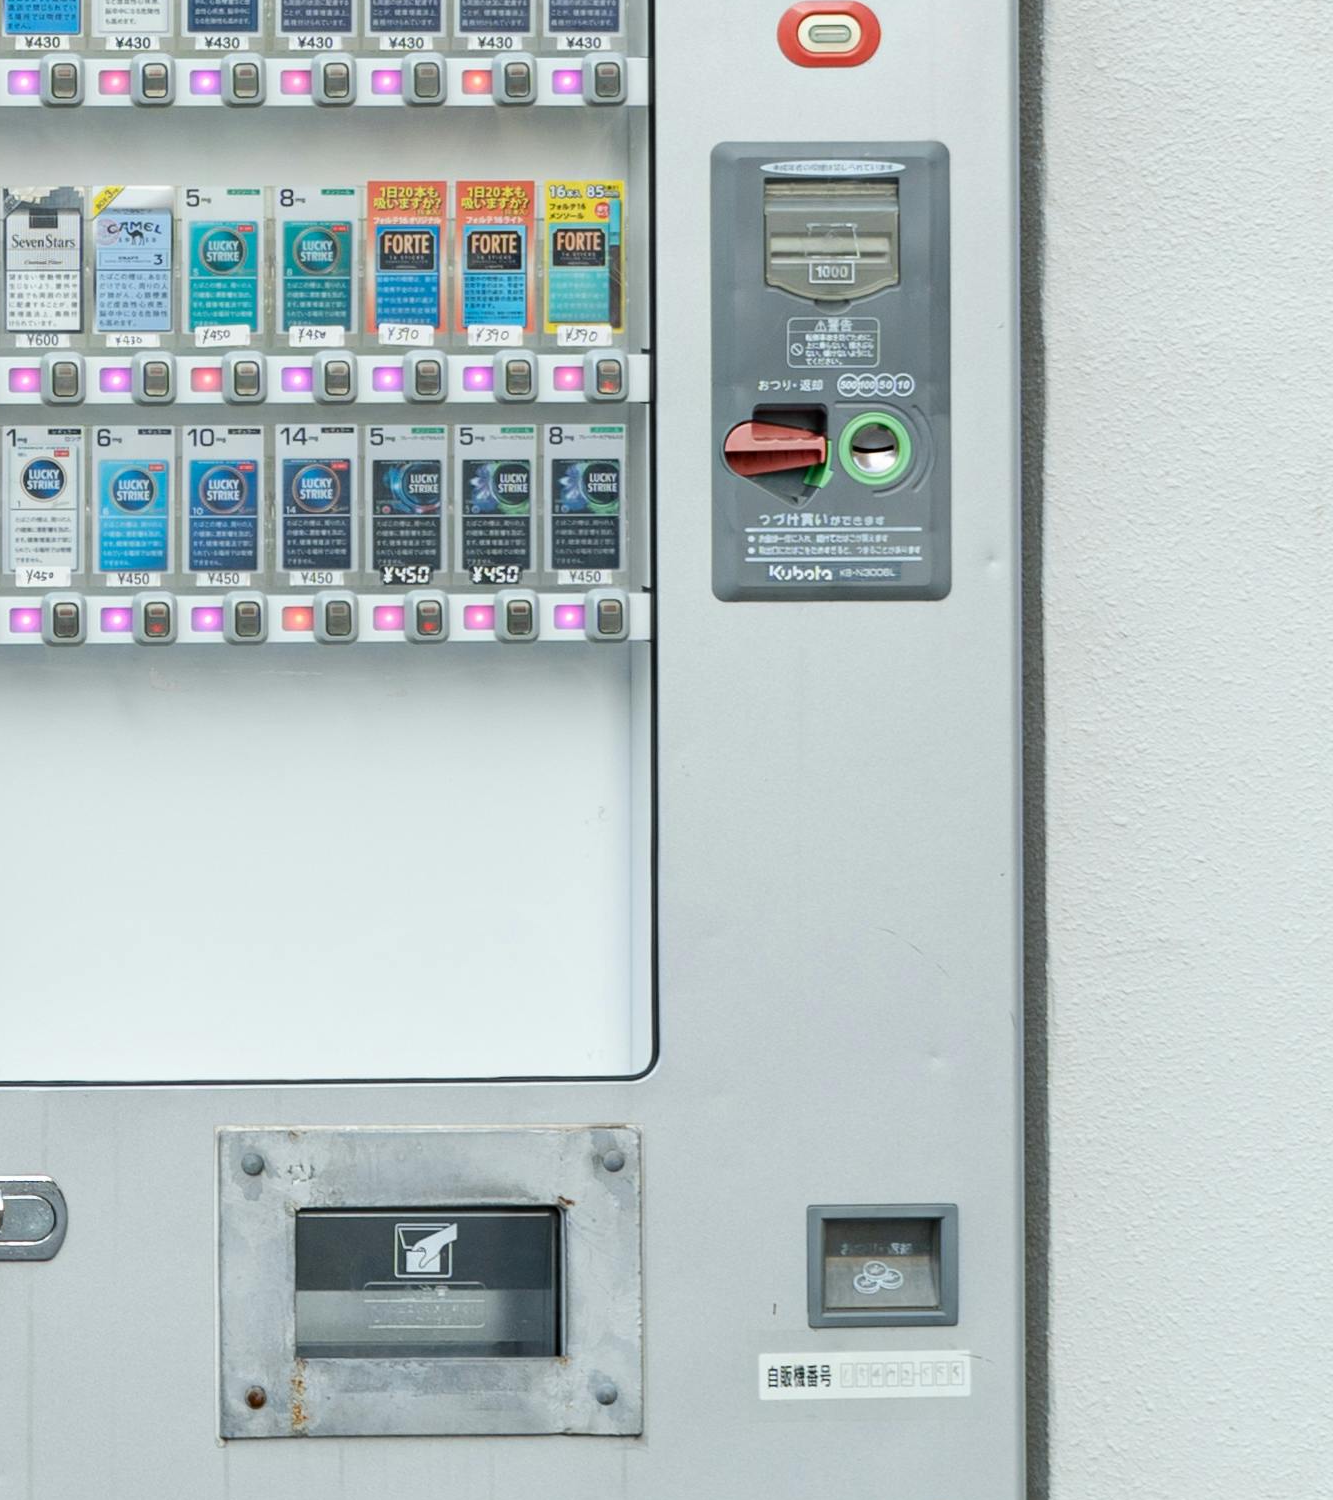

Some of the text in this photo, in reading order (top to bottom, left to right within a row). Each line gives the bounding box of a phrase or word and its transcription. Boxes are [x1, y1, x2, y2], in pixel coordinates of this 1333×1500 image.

[25, 36, 61, 48] ¥430
[297, 36, 333, 50] ¥430
[477, 36, 513, 50] ¥430
[565, 36, 601, 50] ¥430
[549, 203, 585, 211] フォルテ16
[549, 212, 584, 220] メンソール
[208, 240, 239, 251] LUCKY
[302, 240, 334, 251] LUCKY
[384, 233, 430, 254] FORTE
[471, 233, 517, 254] FORTE
[556, 229, 601, 251] FORTE
[206, 251, 240, 263] STRIKE
[300, 251, 334, 262] STRIKE
[815, 264, 849, 280] 1000
[840, 381, 856, 390] 500
[879, 381, 893, 390] 50
[897, 381, 910, 390] 10
[29, 469, 59, 480] LUCKY
[26, 480, 60, 491] STRIKE
[118, 479, 150, 490] LUCKY
[116, 490, 150, 502] STRIKE
[759, 513, 885, 526] つづけ買いができます
[207, 572, 239, 586] ¥450
[769, 565, 833, 581] Kubota
[768, 1364, 832, 1388] 自販機番号
